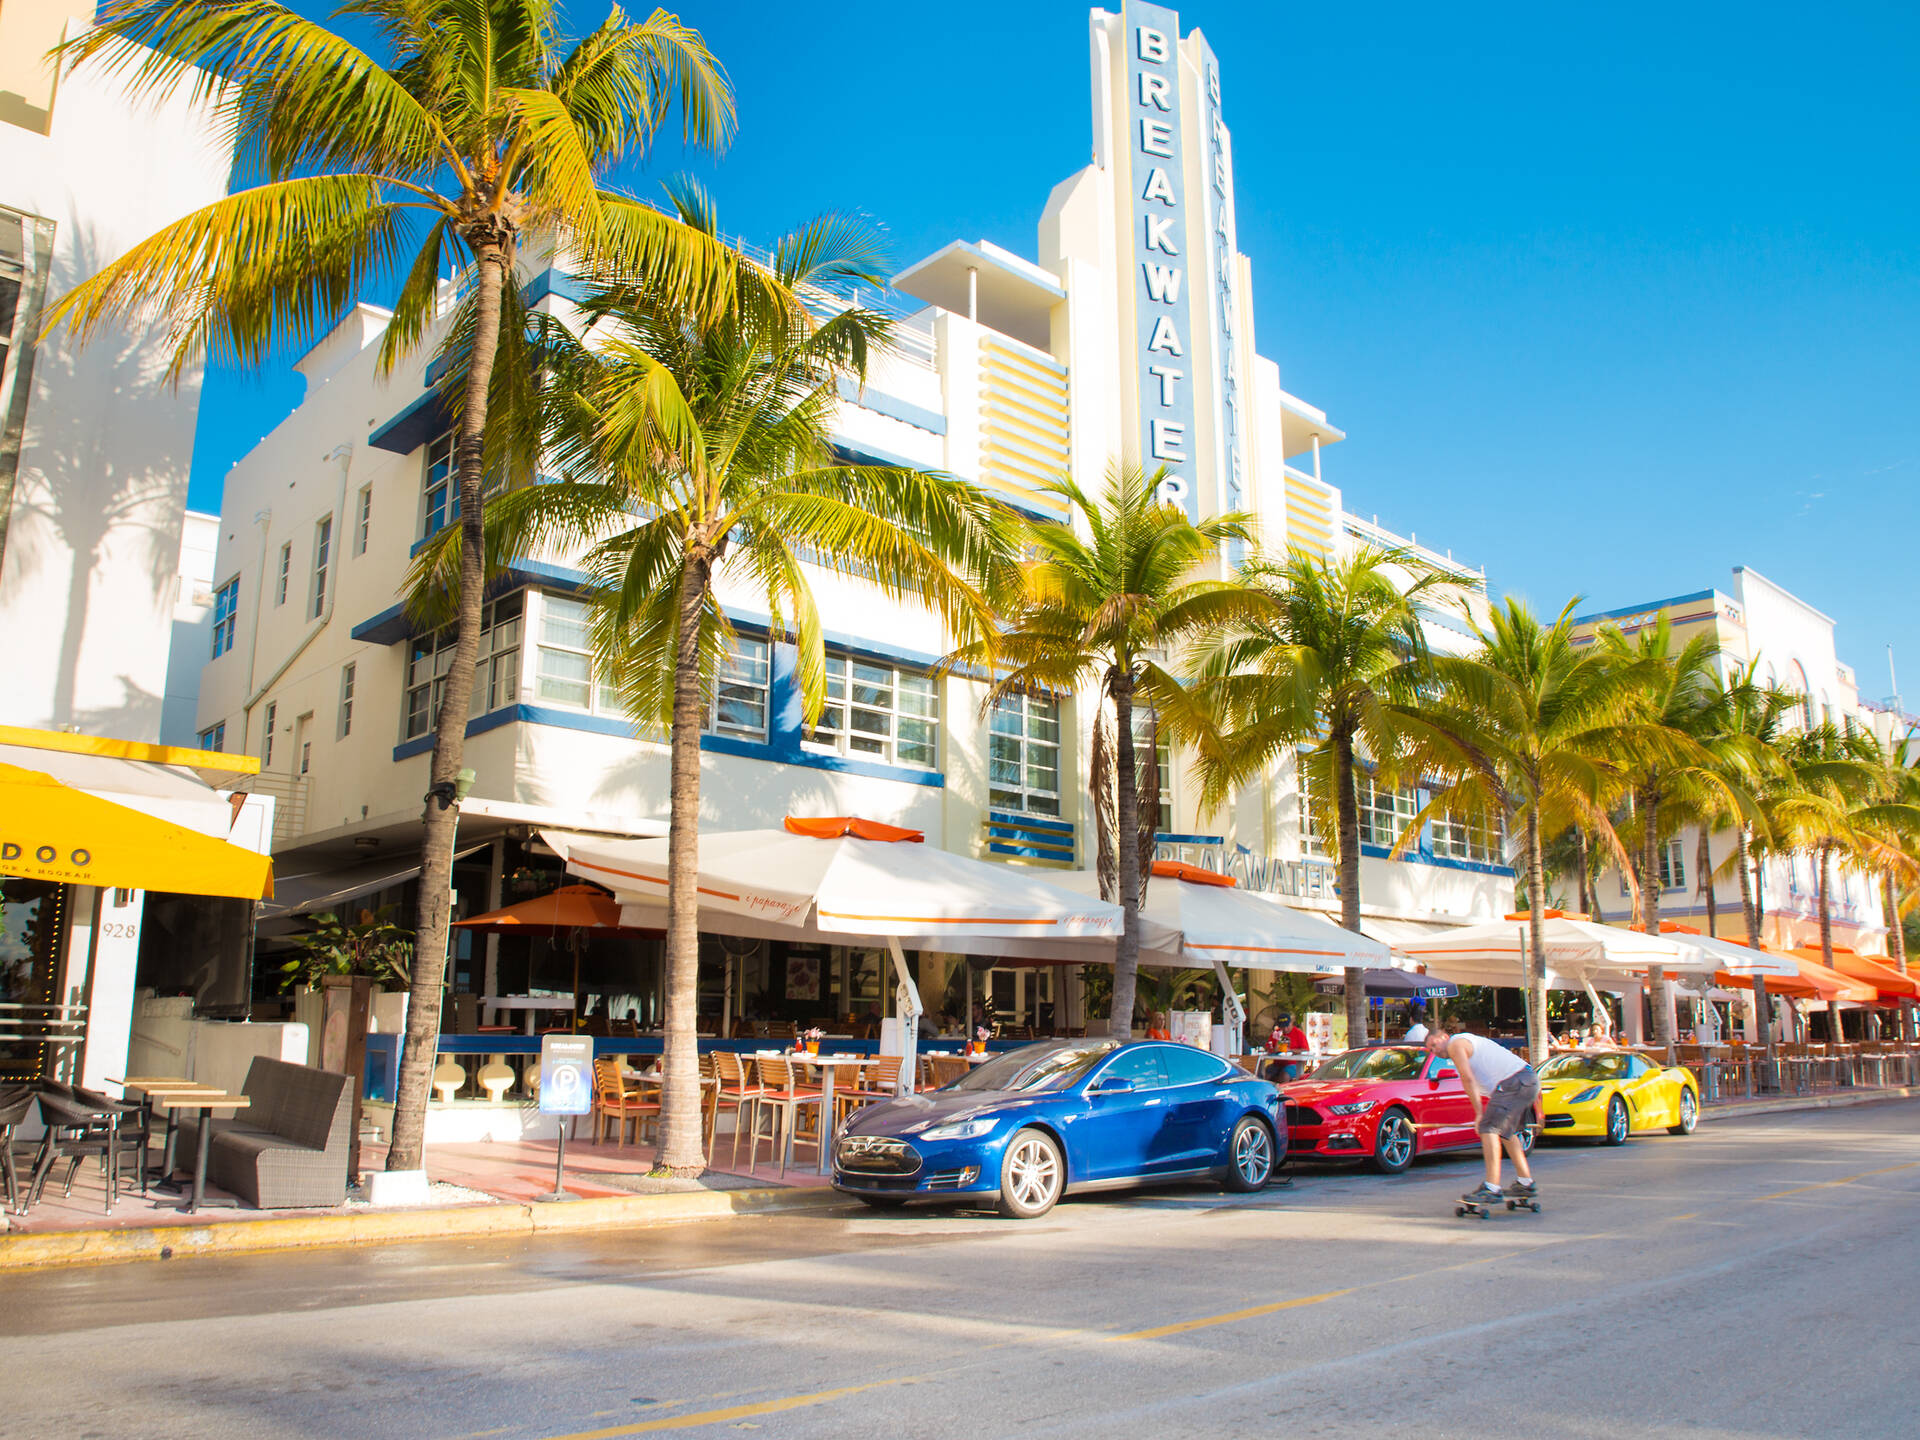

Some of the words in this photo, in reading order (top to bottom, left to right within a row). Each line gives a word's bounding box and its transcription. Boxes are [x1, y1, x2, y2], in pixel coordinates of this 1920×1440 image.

[1136, 25, 1189, 517] BREAKWATER
[1153, 843, 1337, 900] REAKWATER
[103, 922, 136, 939] 928
[1425, 987, 1448, 997] VALET
